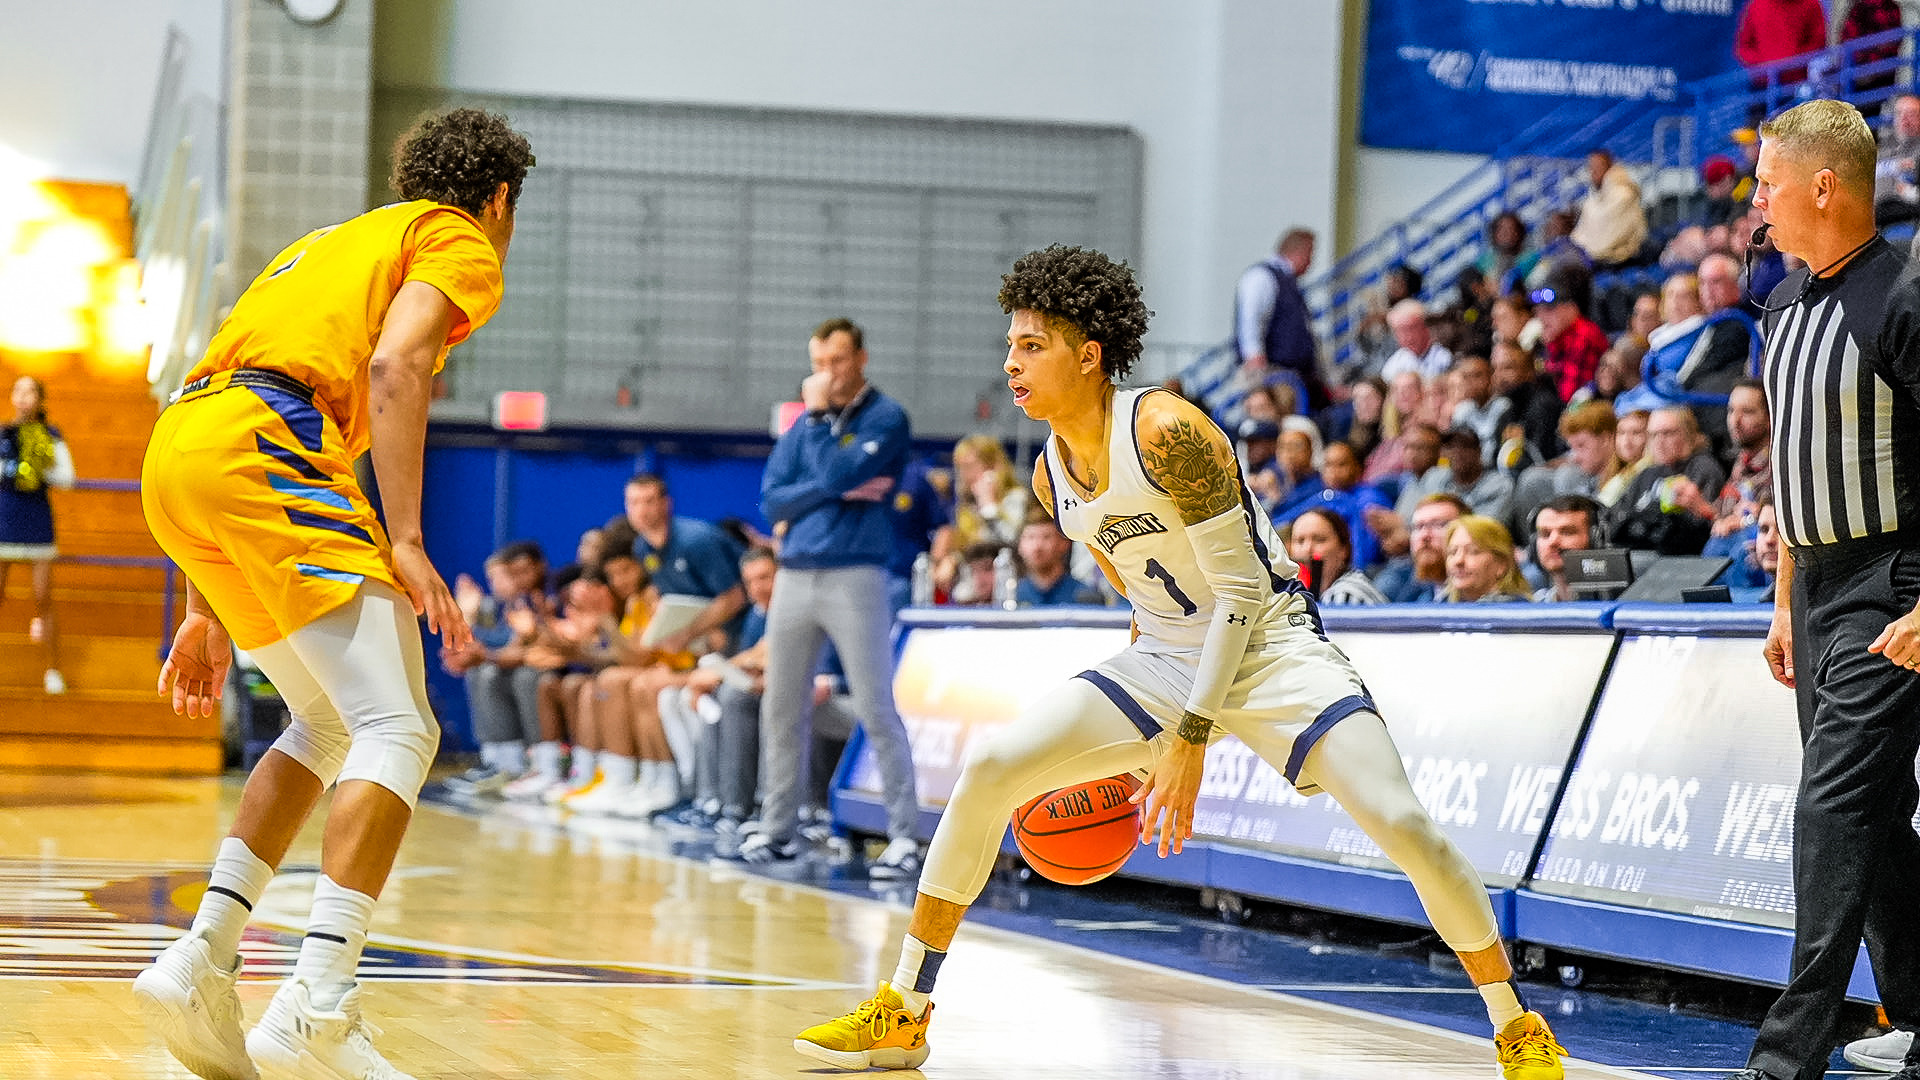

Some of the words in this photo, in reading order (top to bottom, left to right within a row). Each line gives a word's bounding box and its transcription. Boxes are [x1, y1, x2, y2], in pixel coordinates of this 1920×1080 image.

[1095, 526, 1120, 553] THE
[1114, 513, 1167, 540] MOUNT
[1144, 557, 1197, 616] 1
[1045, 789, 1094, 819] ROCK
[1097, 785, 1129, 810] THE
[1600, 772, 1700, 851] BROS.
[1712, 781, 1797, 863] WEI
[1583, 861, 1611, 887] ON
[1611, 864, 1647, 892] YOU
